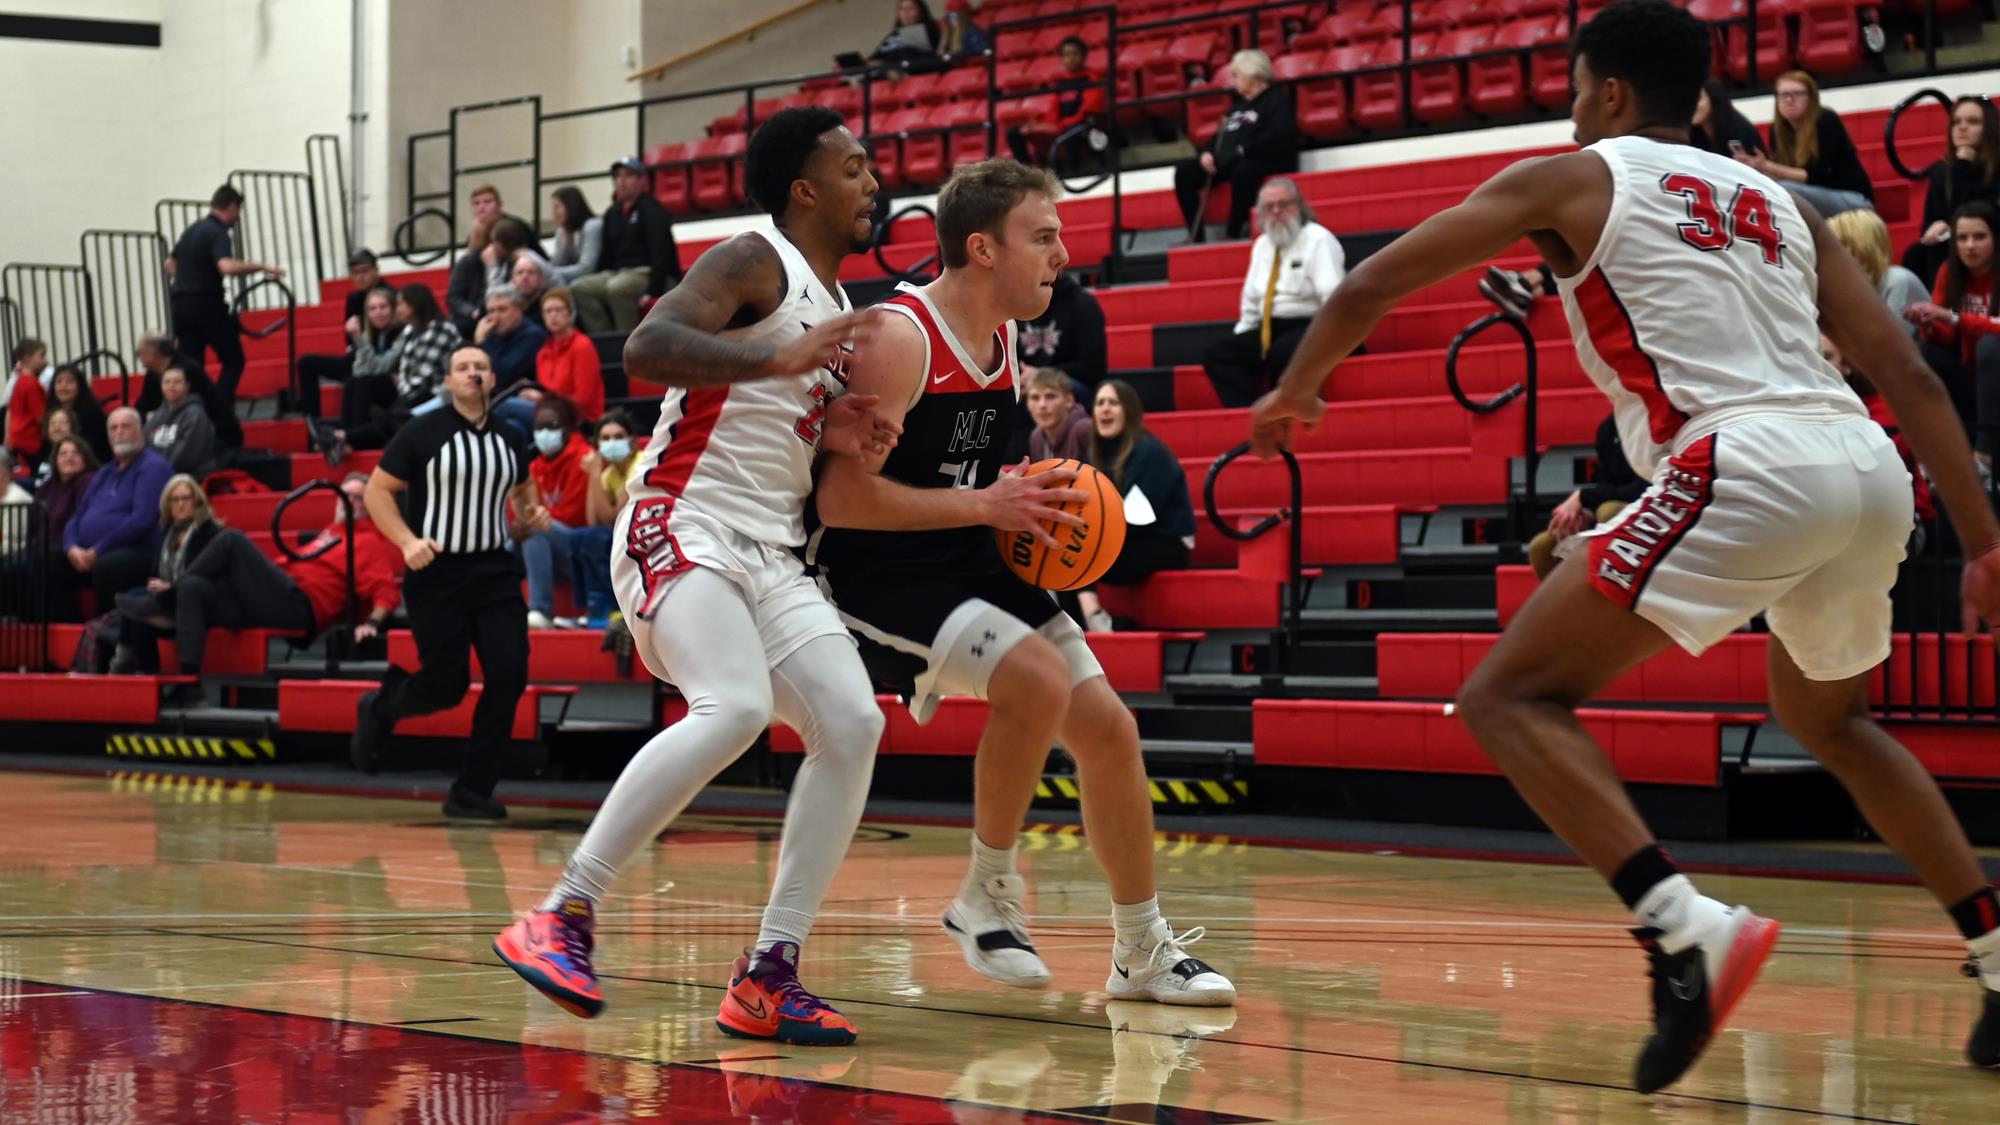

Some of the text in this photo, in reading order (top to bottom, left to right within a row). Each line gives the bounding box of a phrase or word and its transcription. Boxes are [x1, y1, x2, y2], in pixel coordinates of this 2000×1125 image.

[1659, 172, 1787, 269] 34
[793, 383, 834, 447] 2
[947, 408, 997, 452] MLC
[1474, 518, 1488, 545] E
[1357, 581, 1371, 609] D
[1241, 646, 1255, 672] C
